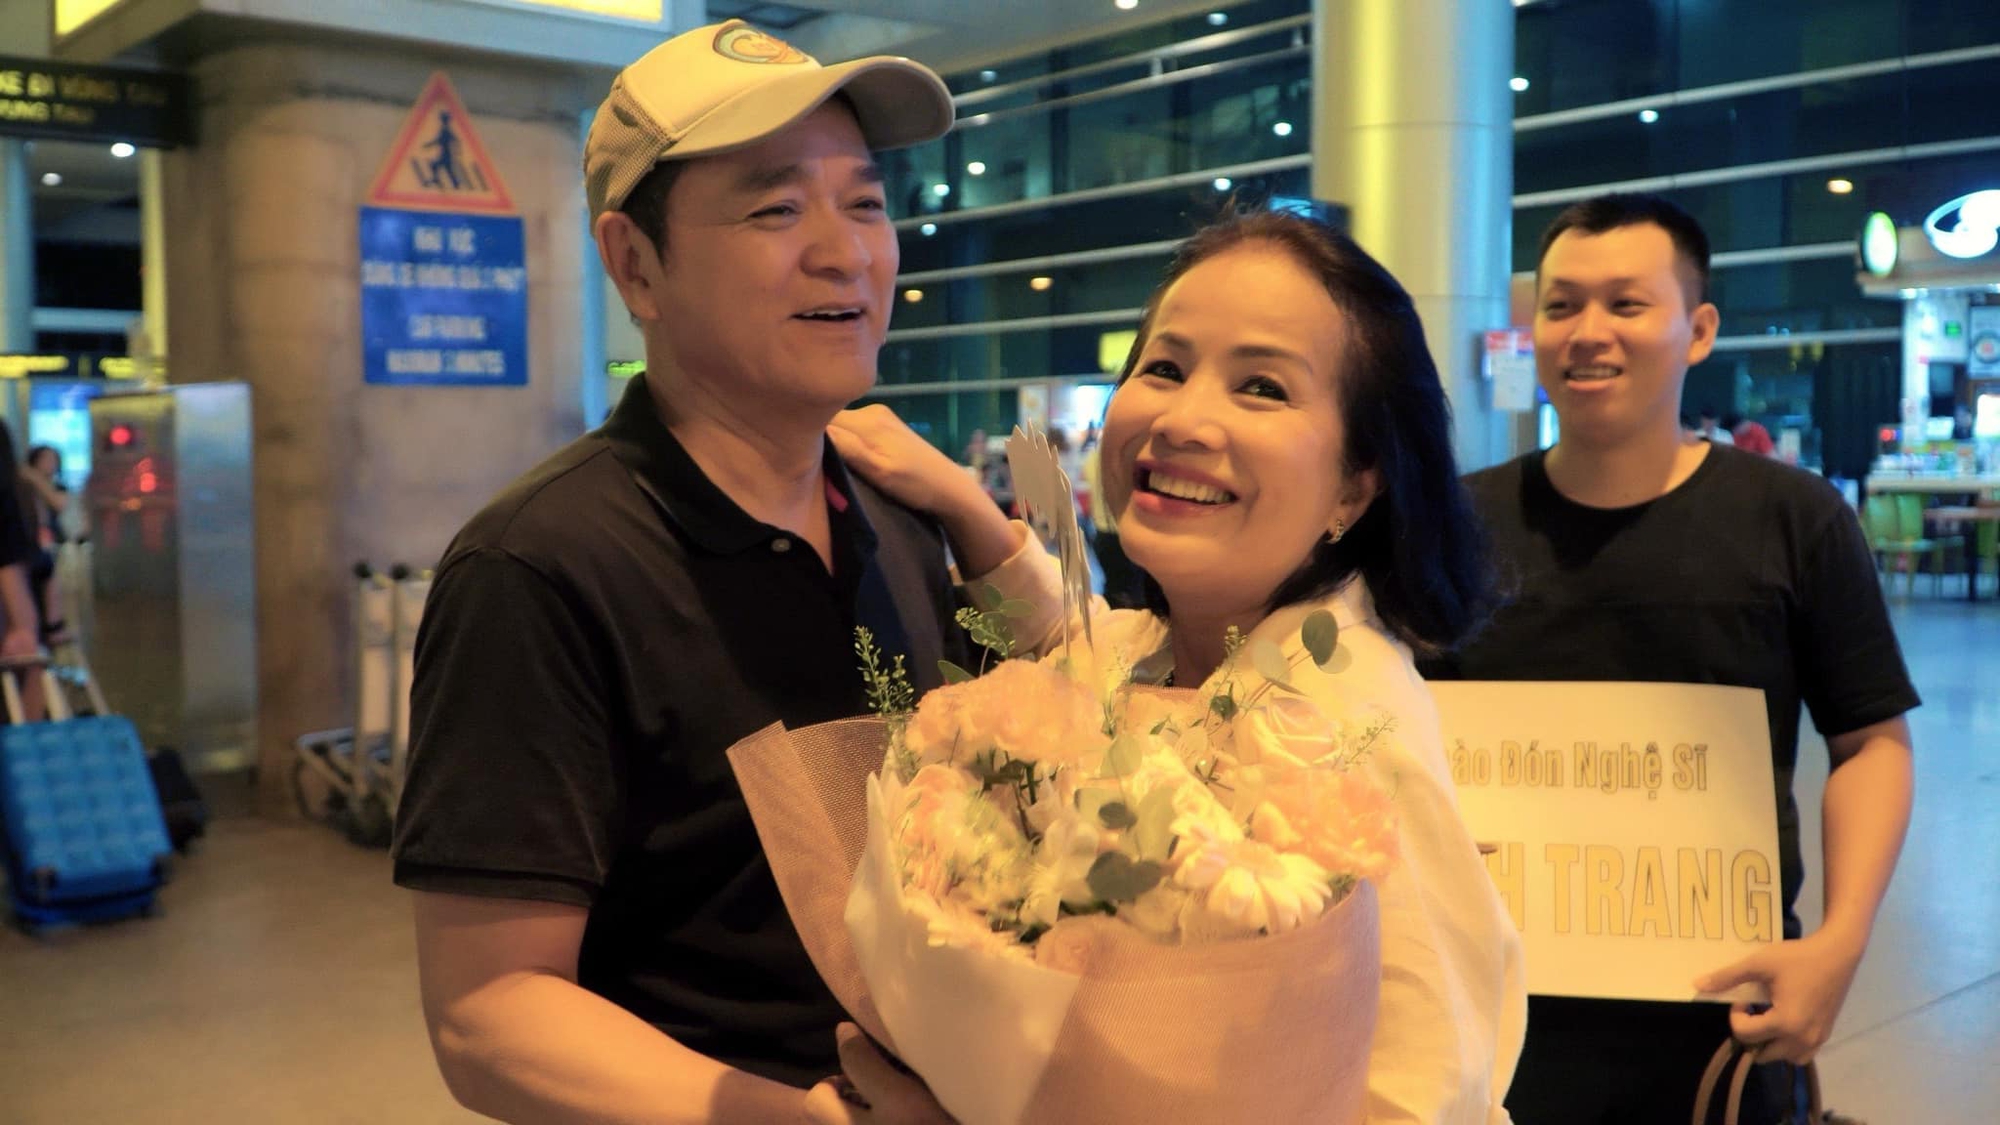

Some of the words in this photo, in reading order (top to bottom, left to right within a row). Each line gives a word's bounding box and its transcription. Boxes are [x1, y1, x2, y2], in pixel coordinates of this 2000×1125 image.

[1451, 738, 1491, 787] ào
[1499, 739, 1564, 788] Đón
[1573, 741, 1663, 800] Nghệ
[1672, 743, 1709, 791] Sĩ
[1545, 843, 1773, 943] TRANG
